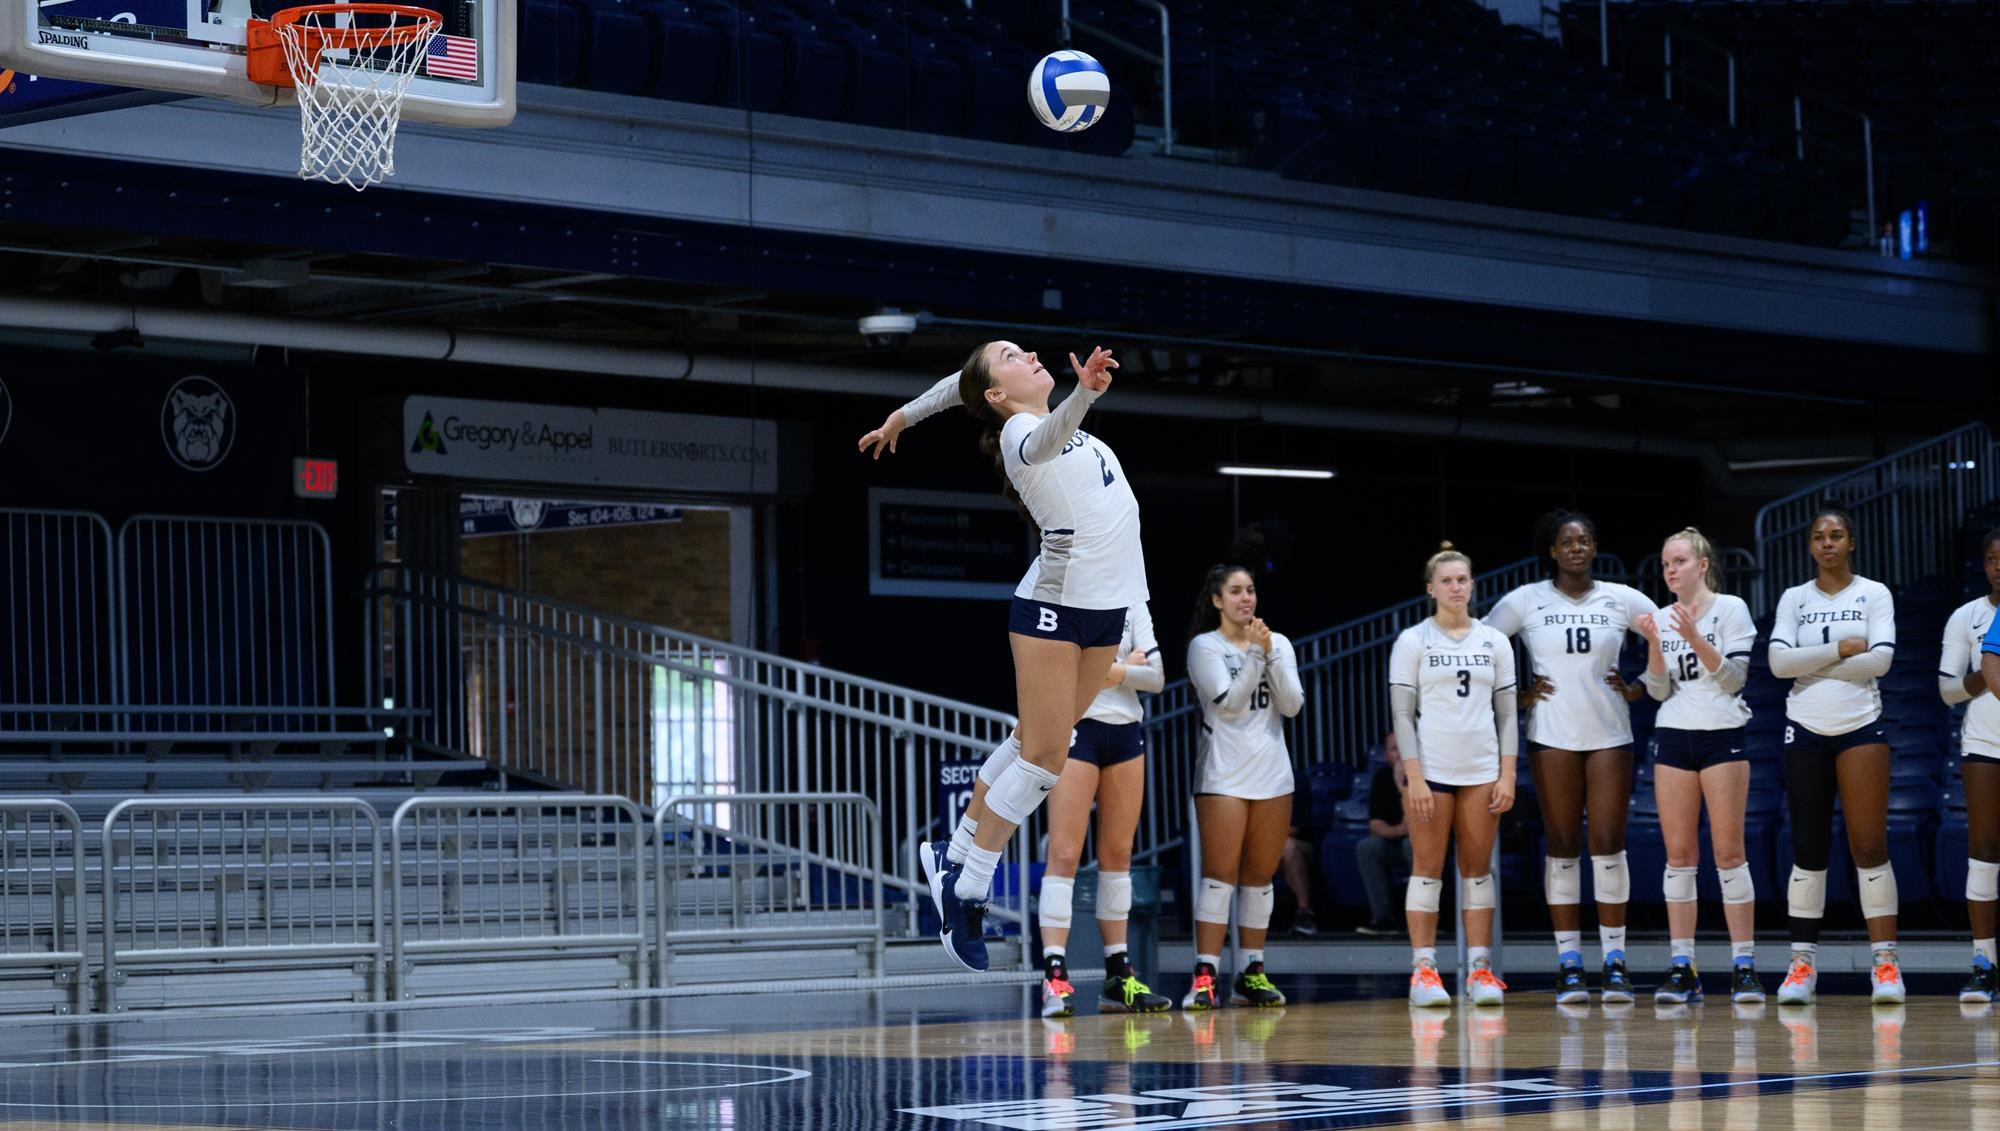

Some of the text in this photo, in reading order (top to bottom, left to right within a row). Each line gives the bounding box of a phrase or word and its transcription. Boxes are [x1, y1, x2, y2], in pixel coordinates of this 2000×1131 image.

[38, 30, 88, 50] SPALDING
[305, 461, 335, 491] EXIT
[1092, 446, 1115, 488] 2
[460, 499, 482, 514] amily
[568, 509, 588, 526] Sec
[637, 503, 655, 520] 124
[1036, 606, 1059, 632] B
[1544, 614, 1610, 626] BUTLER
[1798, 609, 1862, 626] BUTLER
[1565, 627, 1591, 654] 18
[1662, 633, 1717, 653] BUTR
[1822, 625, 1830, 644] 1
[1429, 654, 1492, 667] BUTLER
[1678, 652, 1699, 681] 12
[1456, 670, 1471, 697] 3
[1249, 681, 1270, 711] 16
[1784, 725, 1796, 744] B
[940, 764, 977, 783] SECT
